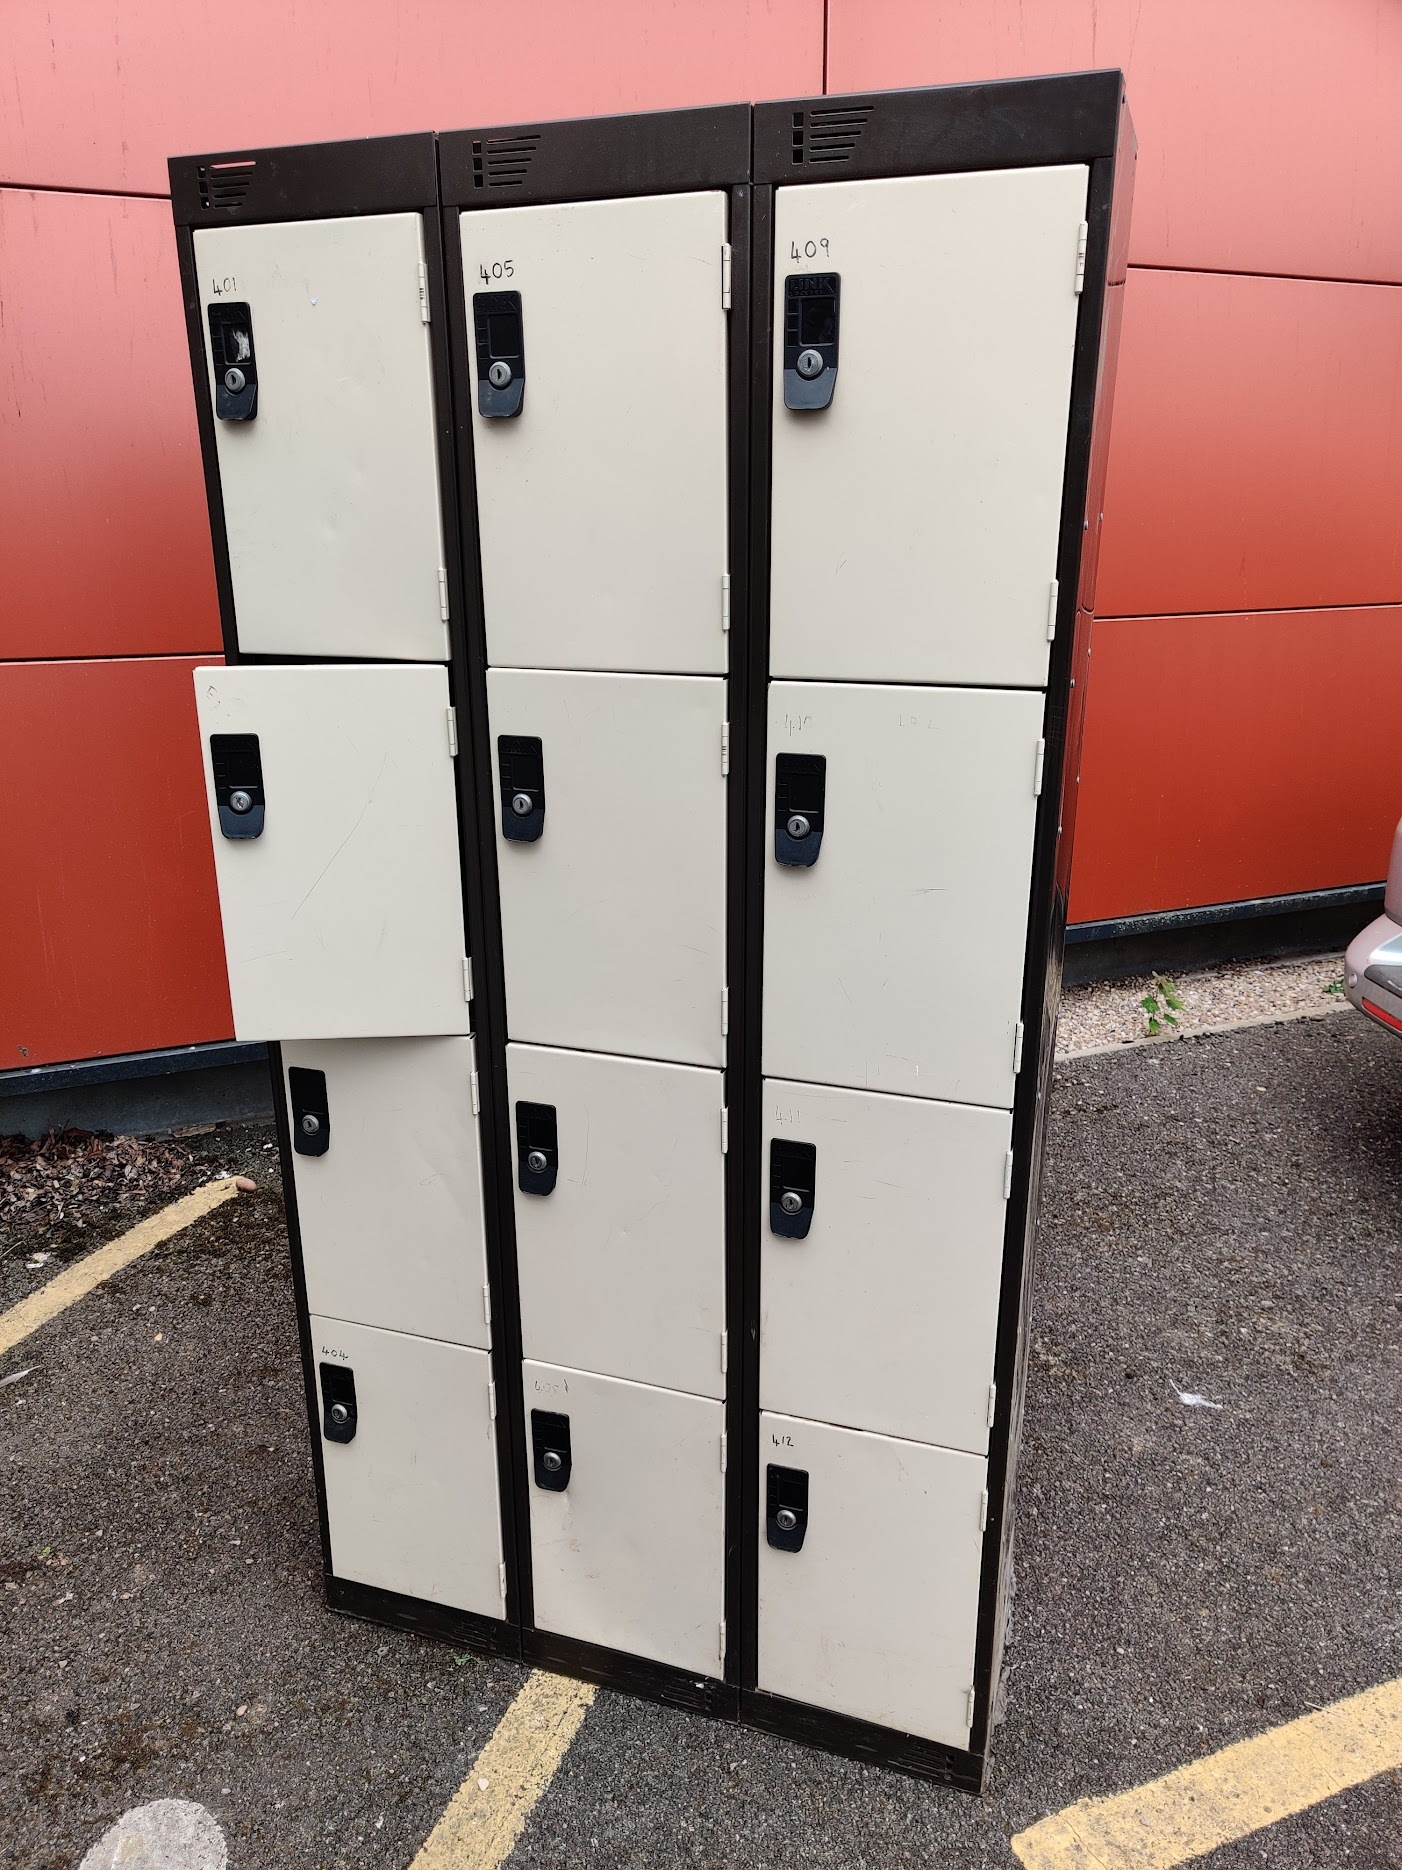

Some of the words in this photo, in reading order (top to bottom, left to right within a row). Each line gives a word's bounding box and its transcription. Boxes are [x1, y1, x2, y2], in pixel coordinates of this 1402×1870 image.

[790, 237, 830, 264] 409
[479, 259, 515, 286] 405
[212, 276, 238, 297] 401
[321, 1345, 349, 1361] 404
[771, 1433, 795, 1447] 412
